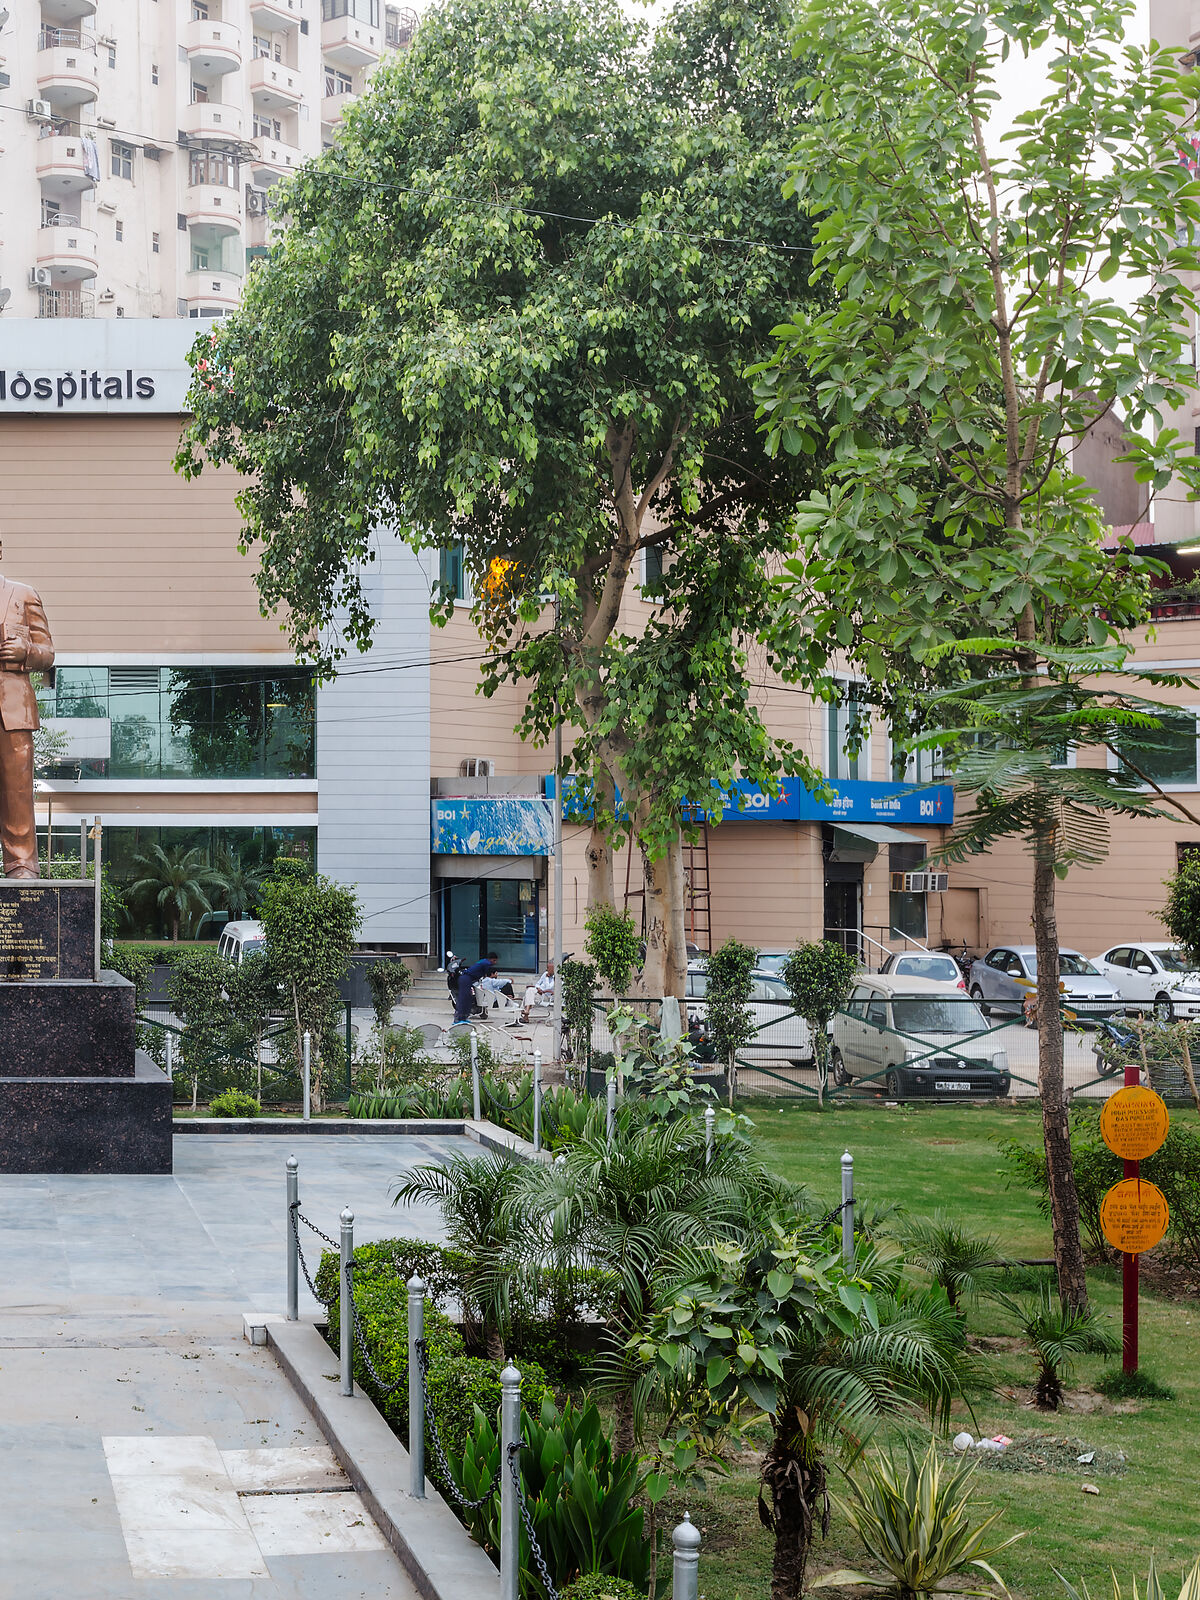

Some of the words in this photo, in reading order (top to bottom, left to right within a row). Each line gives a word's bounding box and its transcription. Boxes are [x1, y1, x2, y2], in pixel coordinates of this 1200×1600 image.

[740, 792, 770, 808] BOI
[920, 800, 934, 816] BOI
[437, 810, 456, 820] BOI
